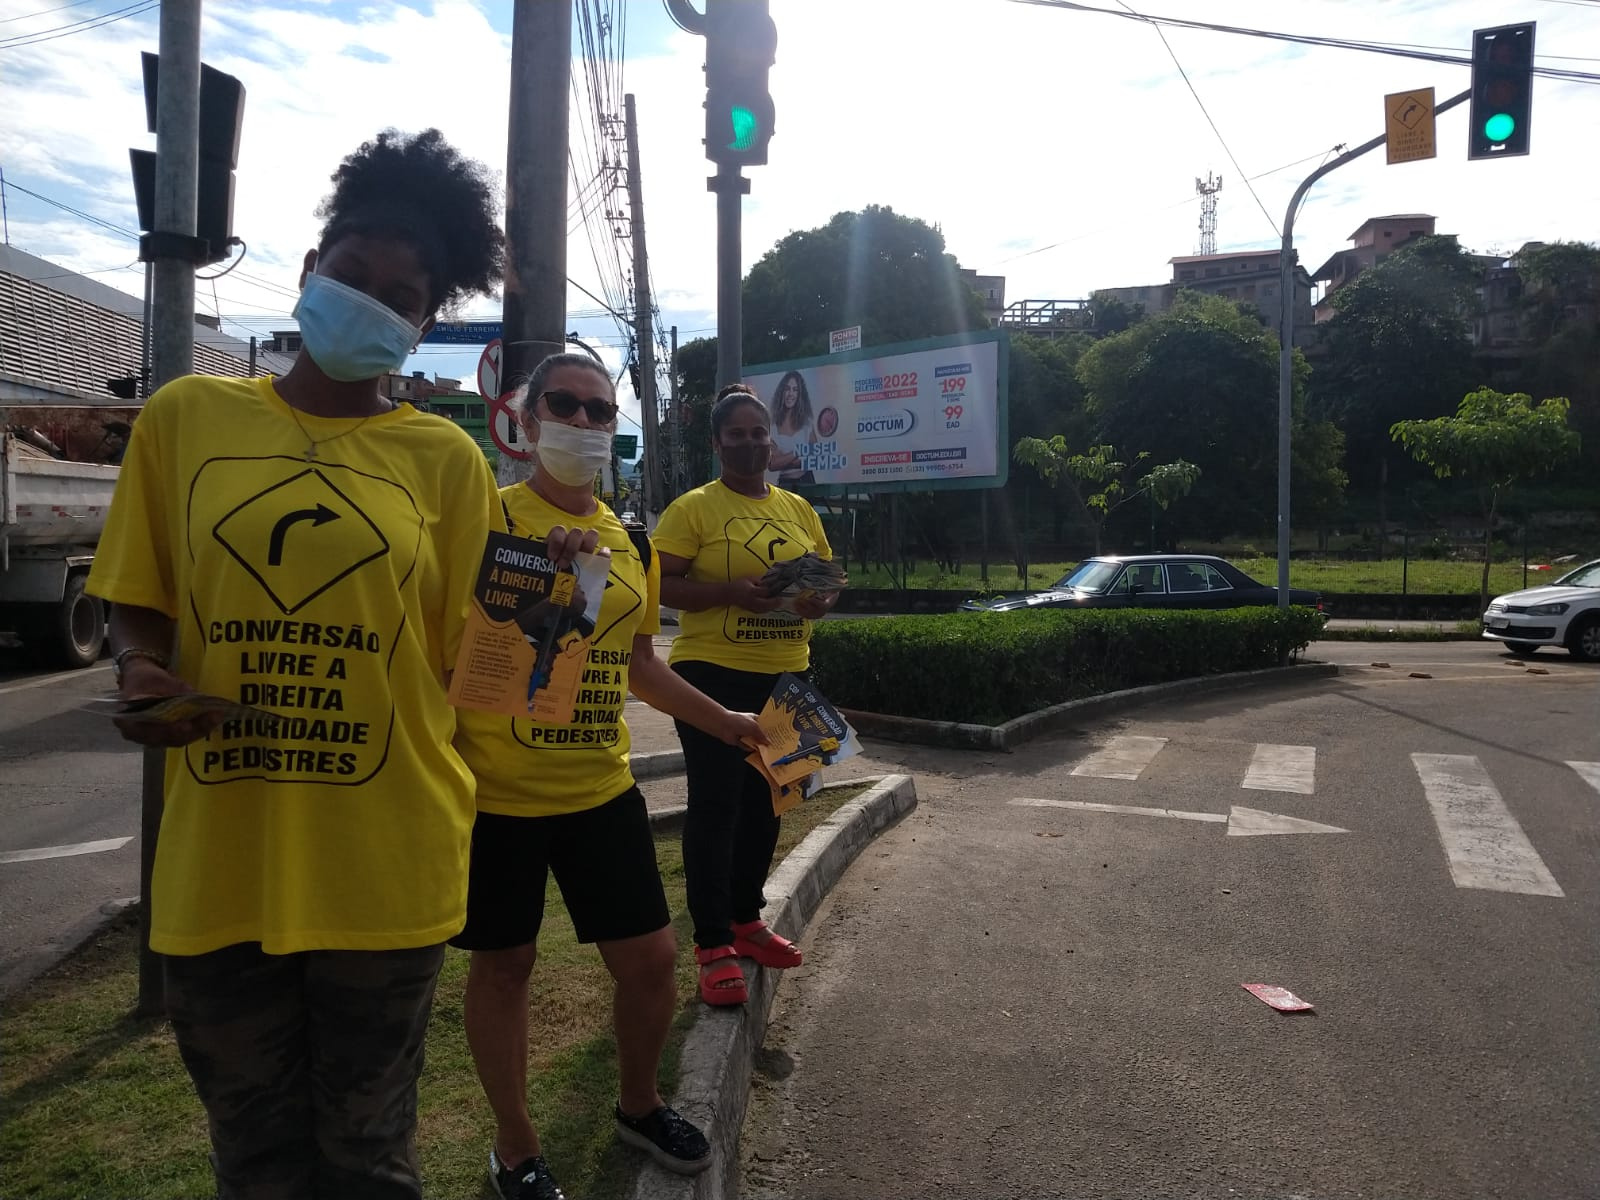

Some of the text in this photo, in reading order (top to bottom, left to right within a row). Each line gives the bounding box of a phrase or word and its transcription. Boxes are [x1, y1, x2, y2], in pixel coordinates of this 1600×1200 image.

[884, 372, 918, 389] 2022
[942, 377, 966, 393] 199
[945, 405, 963, 420] 99
[857, 418, 904, 433] DOCTUM
[946, 421, 960, 429] EAD
[793, 439, 838, 457] NO SEU
[799, 455, 848, 471] TEMPO
[494, 547, 561, 575] CONVERSÃ
[500, 570, 545, 594] DIREITA
[484, 588, 520, 610] LIVRE
[737, 616, 806, 629] PRIORIDADE
[208, 619, 381, 654] CONVERSÃO
[736, 629, 804, 641] PEDESTRES
[240, 651, 348, 681] LIVRE A
[586, 649, 632, 667] ERSÃO
[580, 669, 622, 686] VRE A
[239, 683, 345, 712] DIREITA
[575, 689, 622, 706] IREITA
[797, 713, 813, 732] LIVRE
[810, 714, 829, 735] DIREITA
[816, 704, 844, 736] CONVERSÃO
[203, 717, 371, 746] RIORIDADE
[530, 727, 620, 745] PEDESTRES
